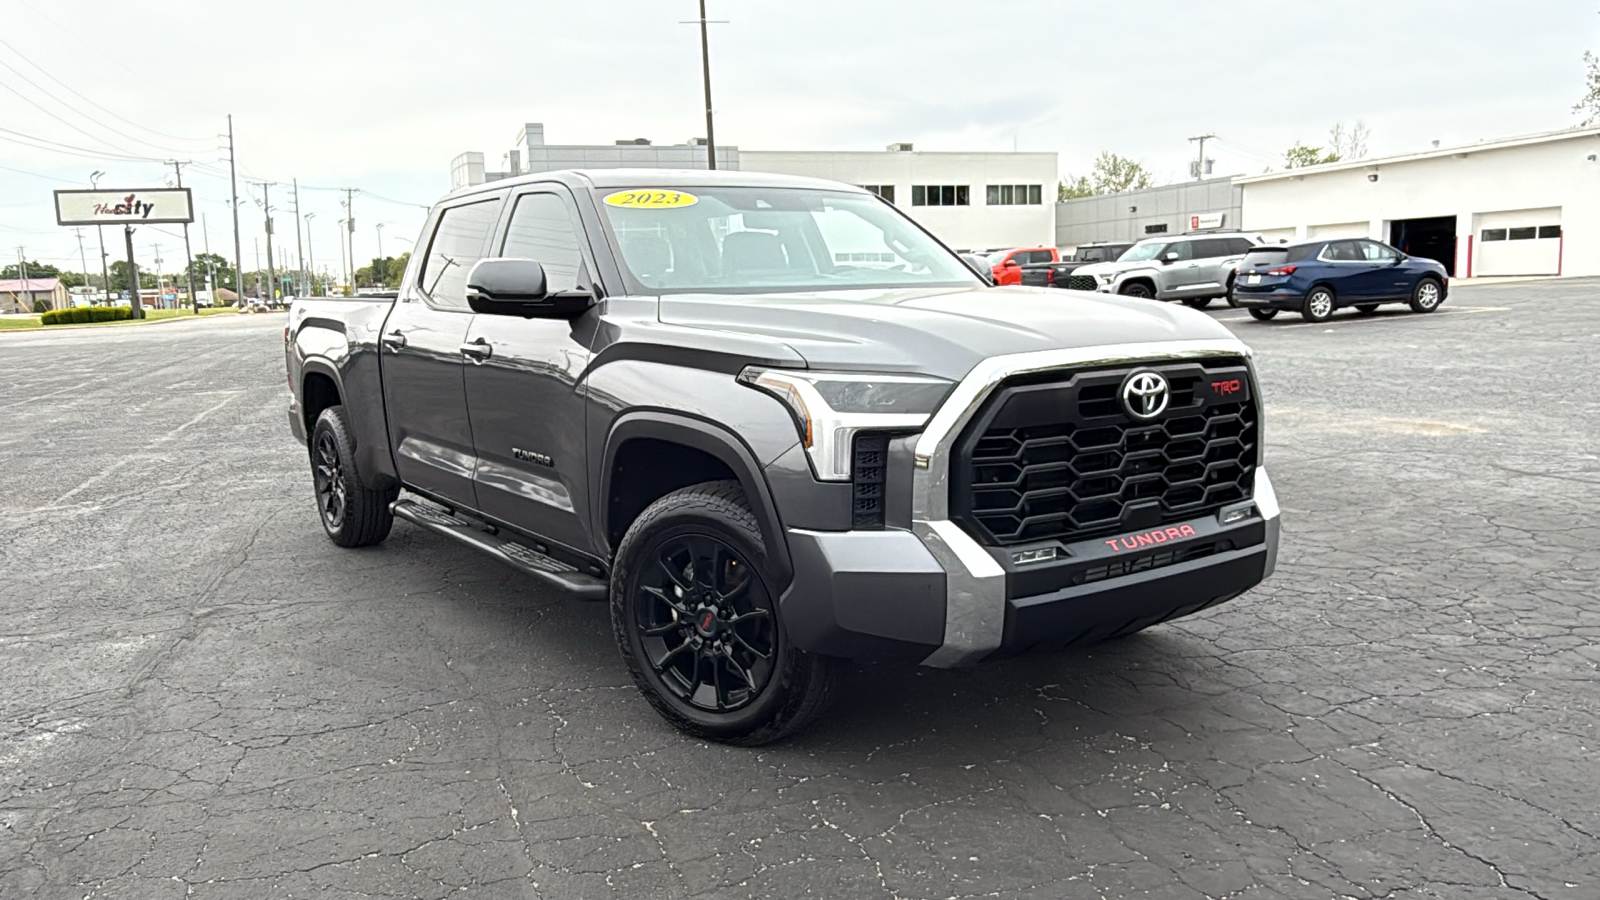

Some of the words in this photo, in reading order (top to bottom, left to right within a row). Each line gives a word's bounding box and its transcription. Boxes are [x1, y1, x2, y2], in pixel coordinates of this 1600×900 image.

[621, 193, 681, 204] 2023
[1211, 379, 1240, 396] TRD
[512, 447, 554, 467] TUNDRA
[1105, 524, 1196, 552] TUNDRA
